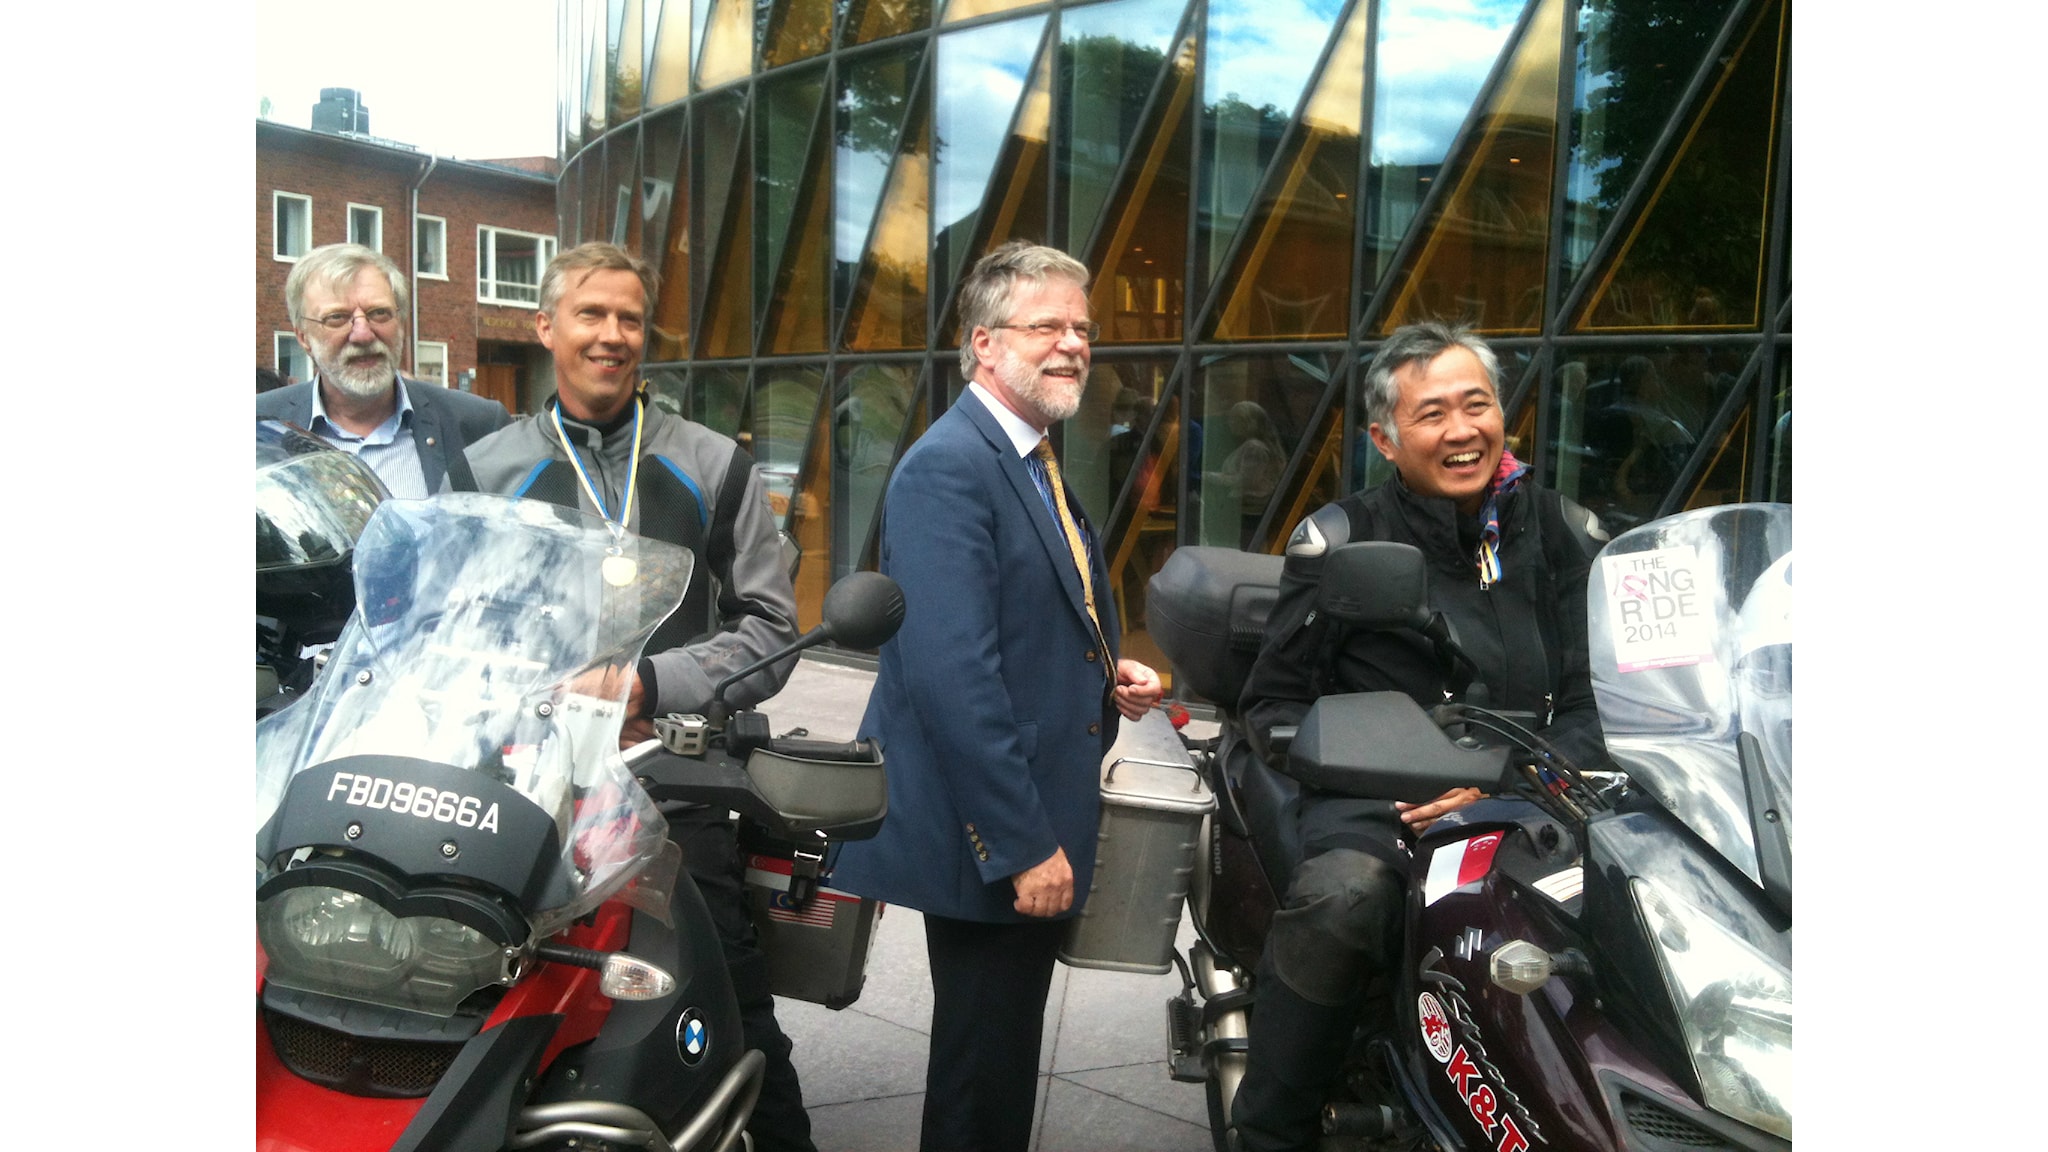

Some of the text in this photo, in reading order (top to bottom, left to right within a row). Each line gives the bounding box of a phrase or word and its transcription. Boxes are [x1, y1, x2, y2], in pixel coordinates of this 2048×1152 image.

[1632, 556, 1667, 572] THE
[1620, 593, 1699, 625] RDE
[1624, 622, 1677, 644] 2014
[327, 772, 499, 834] FBD9666A
[1446, 1043, 1529, 1152] K&T
